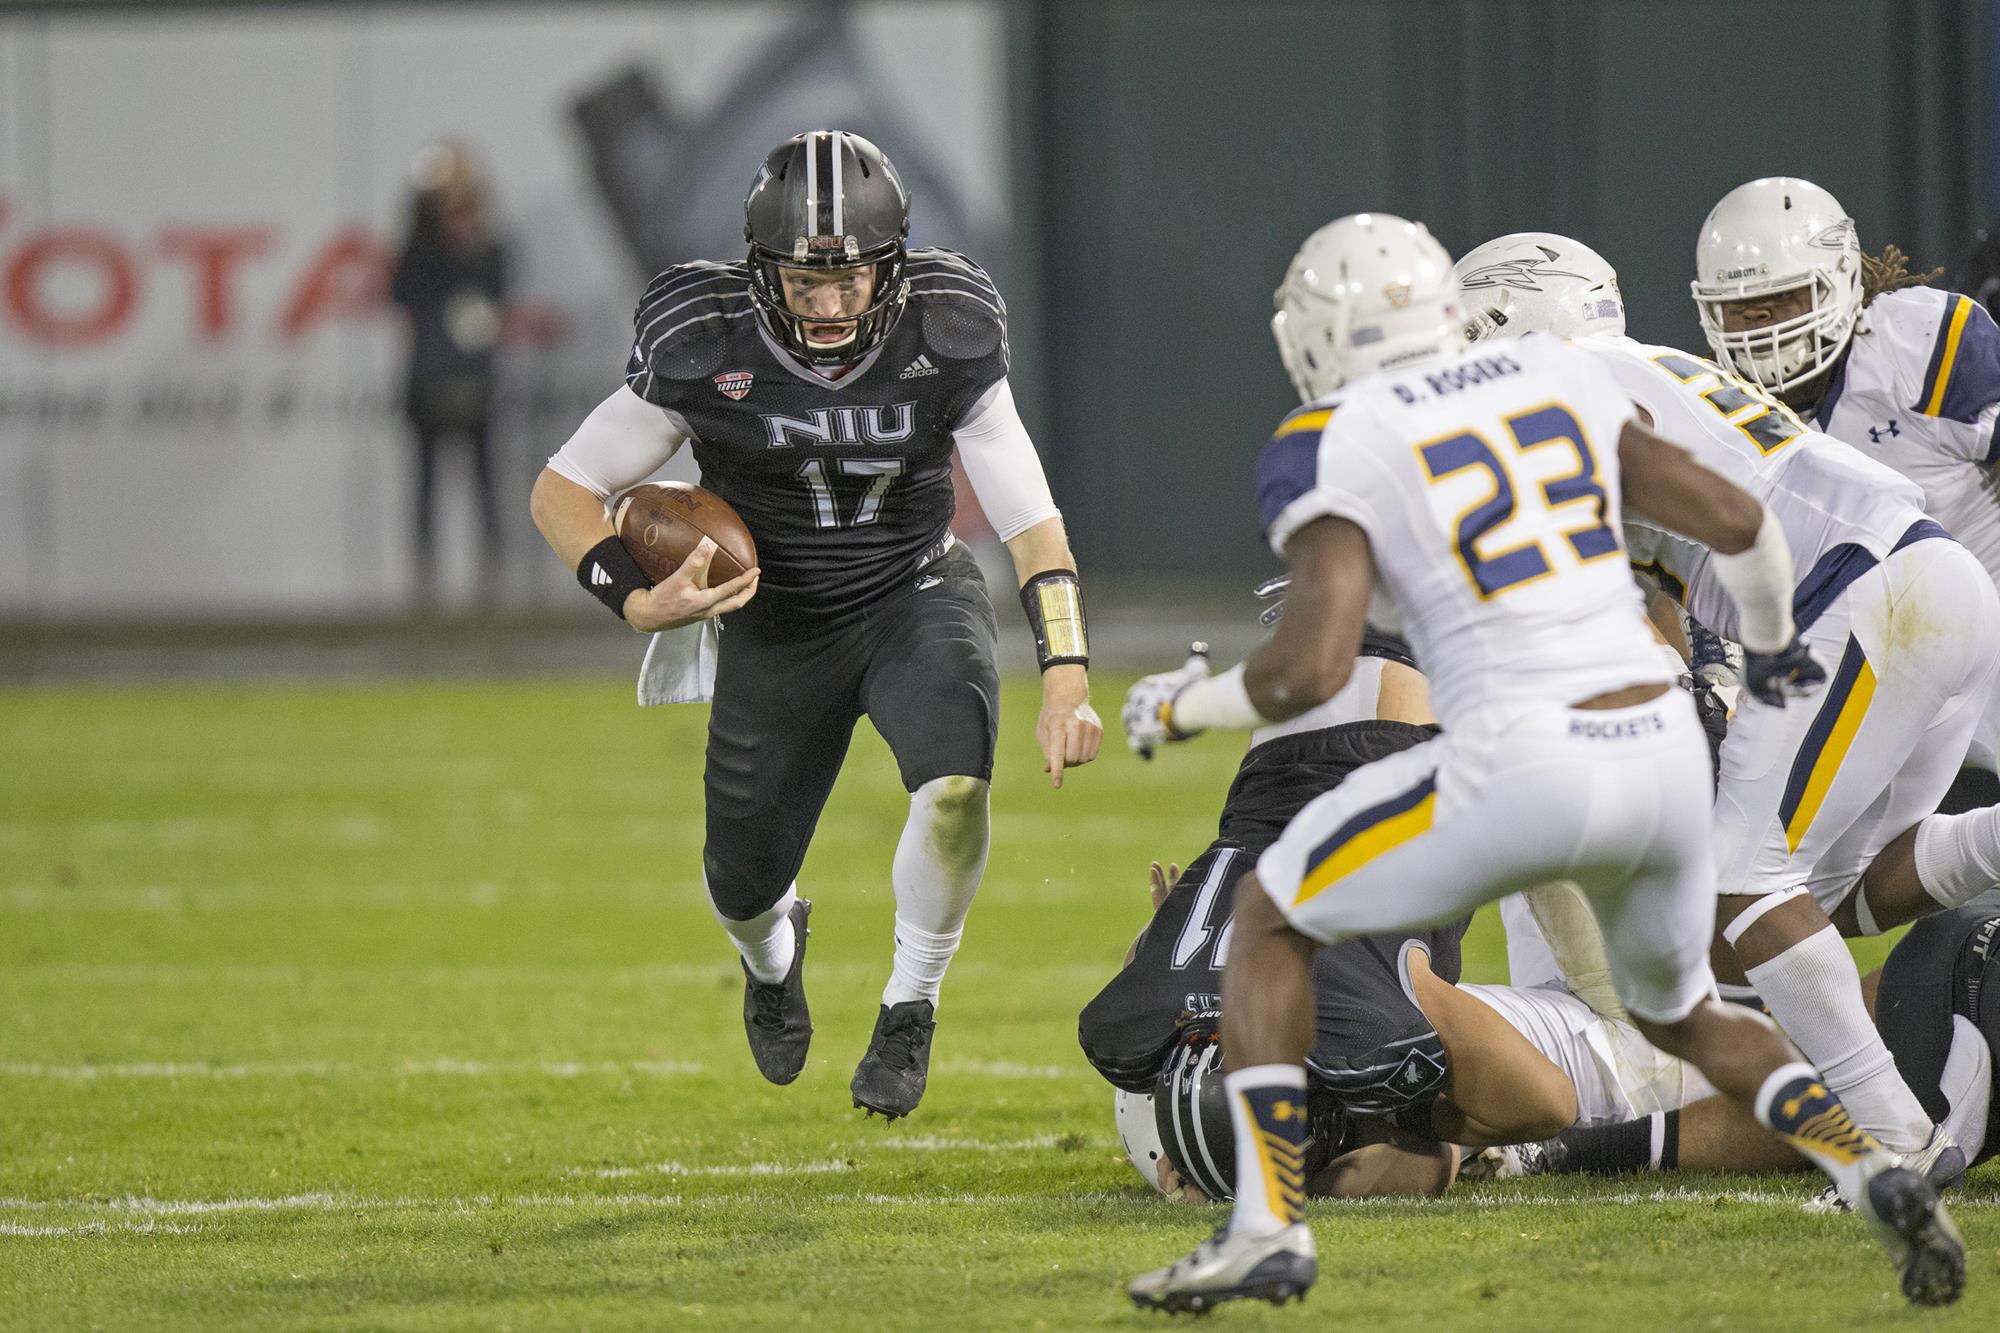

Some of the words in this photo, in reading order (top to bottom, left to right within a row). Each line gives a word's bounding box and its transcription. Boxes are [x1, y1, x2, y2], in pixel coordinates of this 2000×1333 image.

[899, 367, 939, 380] adidas
[758, 400, 918, 448] NIU
[795, 456, 906, 529] 17
[1411, 401, 1627, 603] 23
[1568, 712, 1665, 739] ROCKETS
